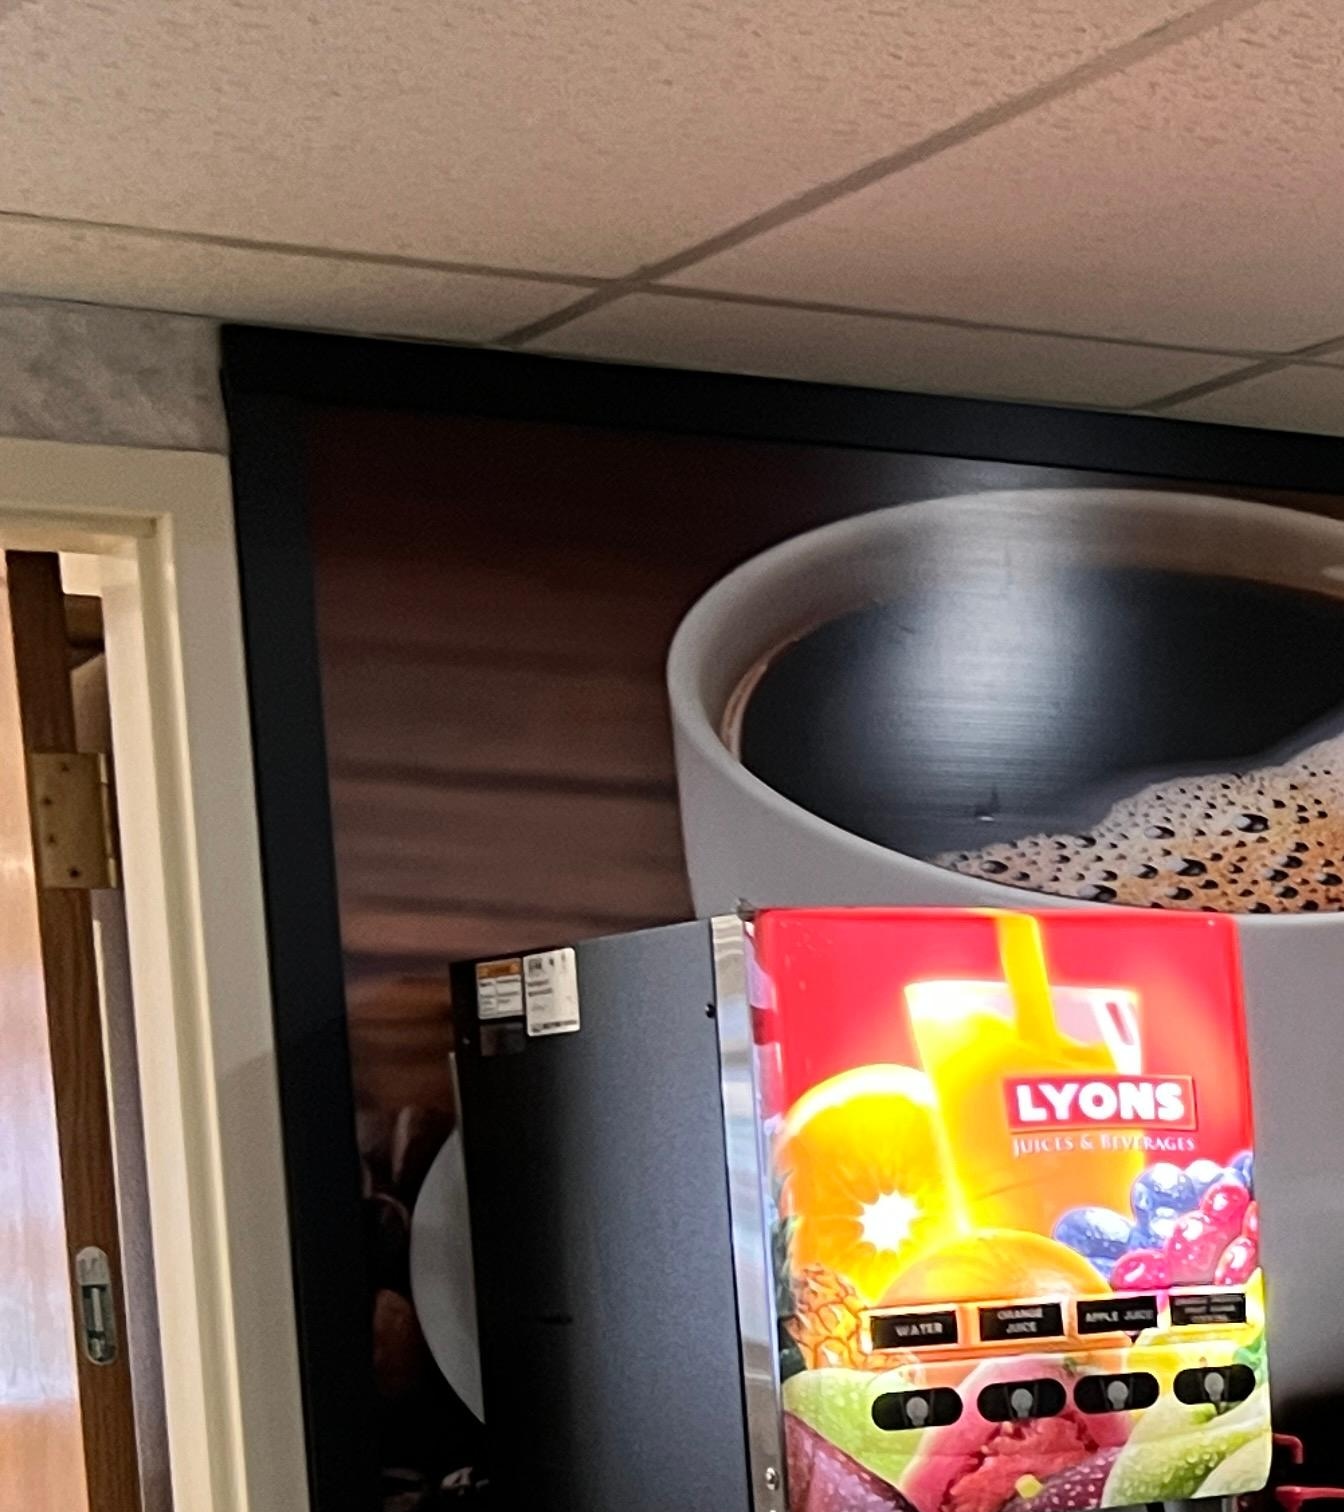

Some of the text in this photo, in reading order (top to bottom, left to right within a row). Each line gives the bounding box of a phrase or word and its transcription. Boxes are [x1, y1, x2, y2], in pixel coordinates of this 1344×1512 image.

[1016, 1082, 1185, 1122] LYONS
[1079, 1133, 1094, 1150] &
[895, 1322, 943, 1337] WATER
